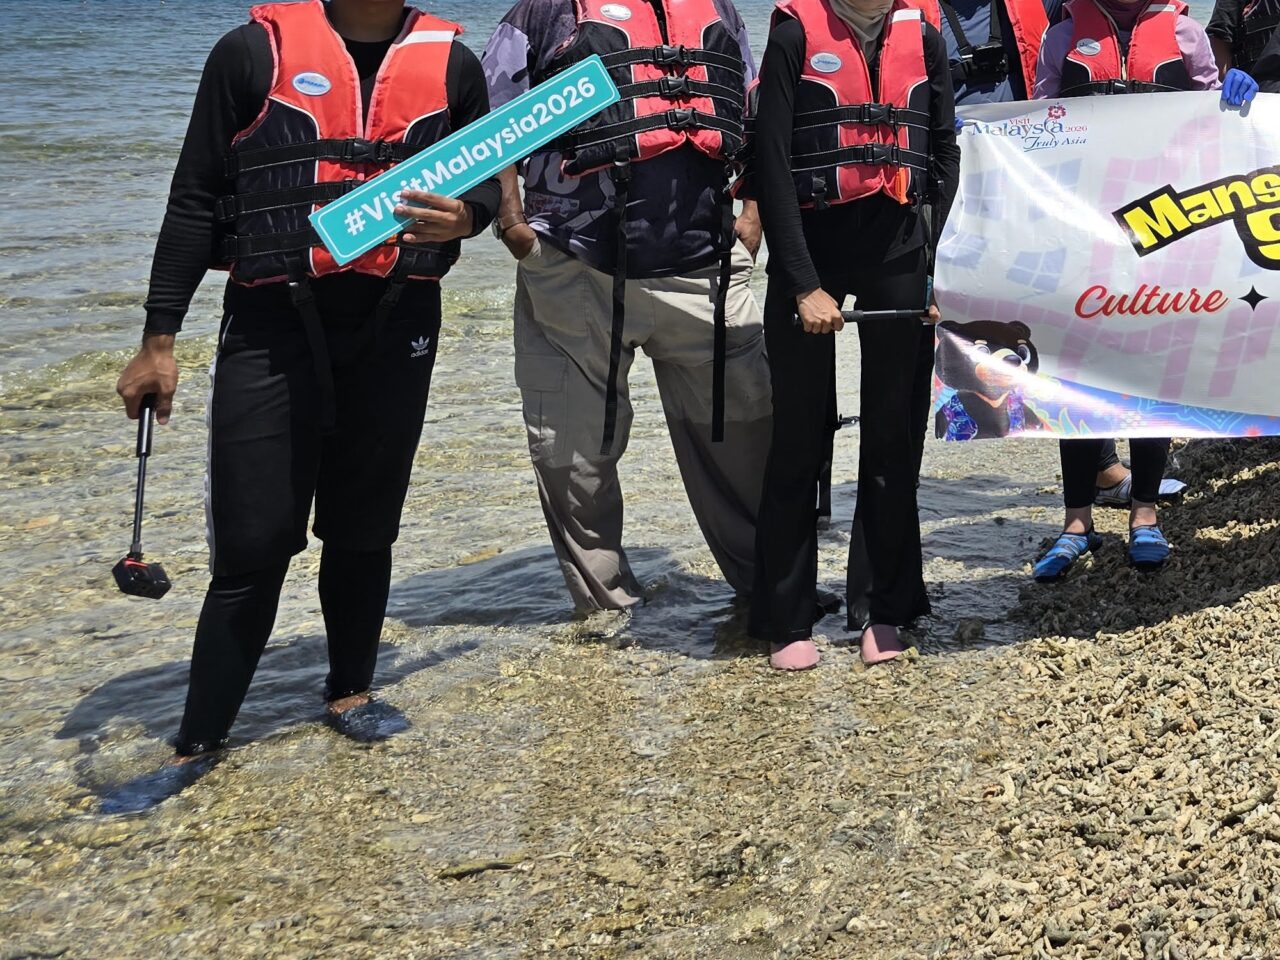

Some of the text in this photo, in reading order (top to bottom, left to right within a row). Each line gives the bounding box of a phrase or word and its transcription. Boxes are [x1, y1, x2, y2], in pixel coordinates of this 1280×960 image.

[972, 120, 1064, 139] Malaysia
[1023, 137, 1087, 152] Truly Asia
[1074, 284, 1231, 319] Culture
